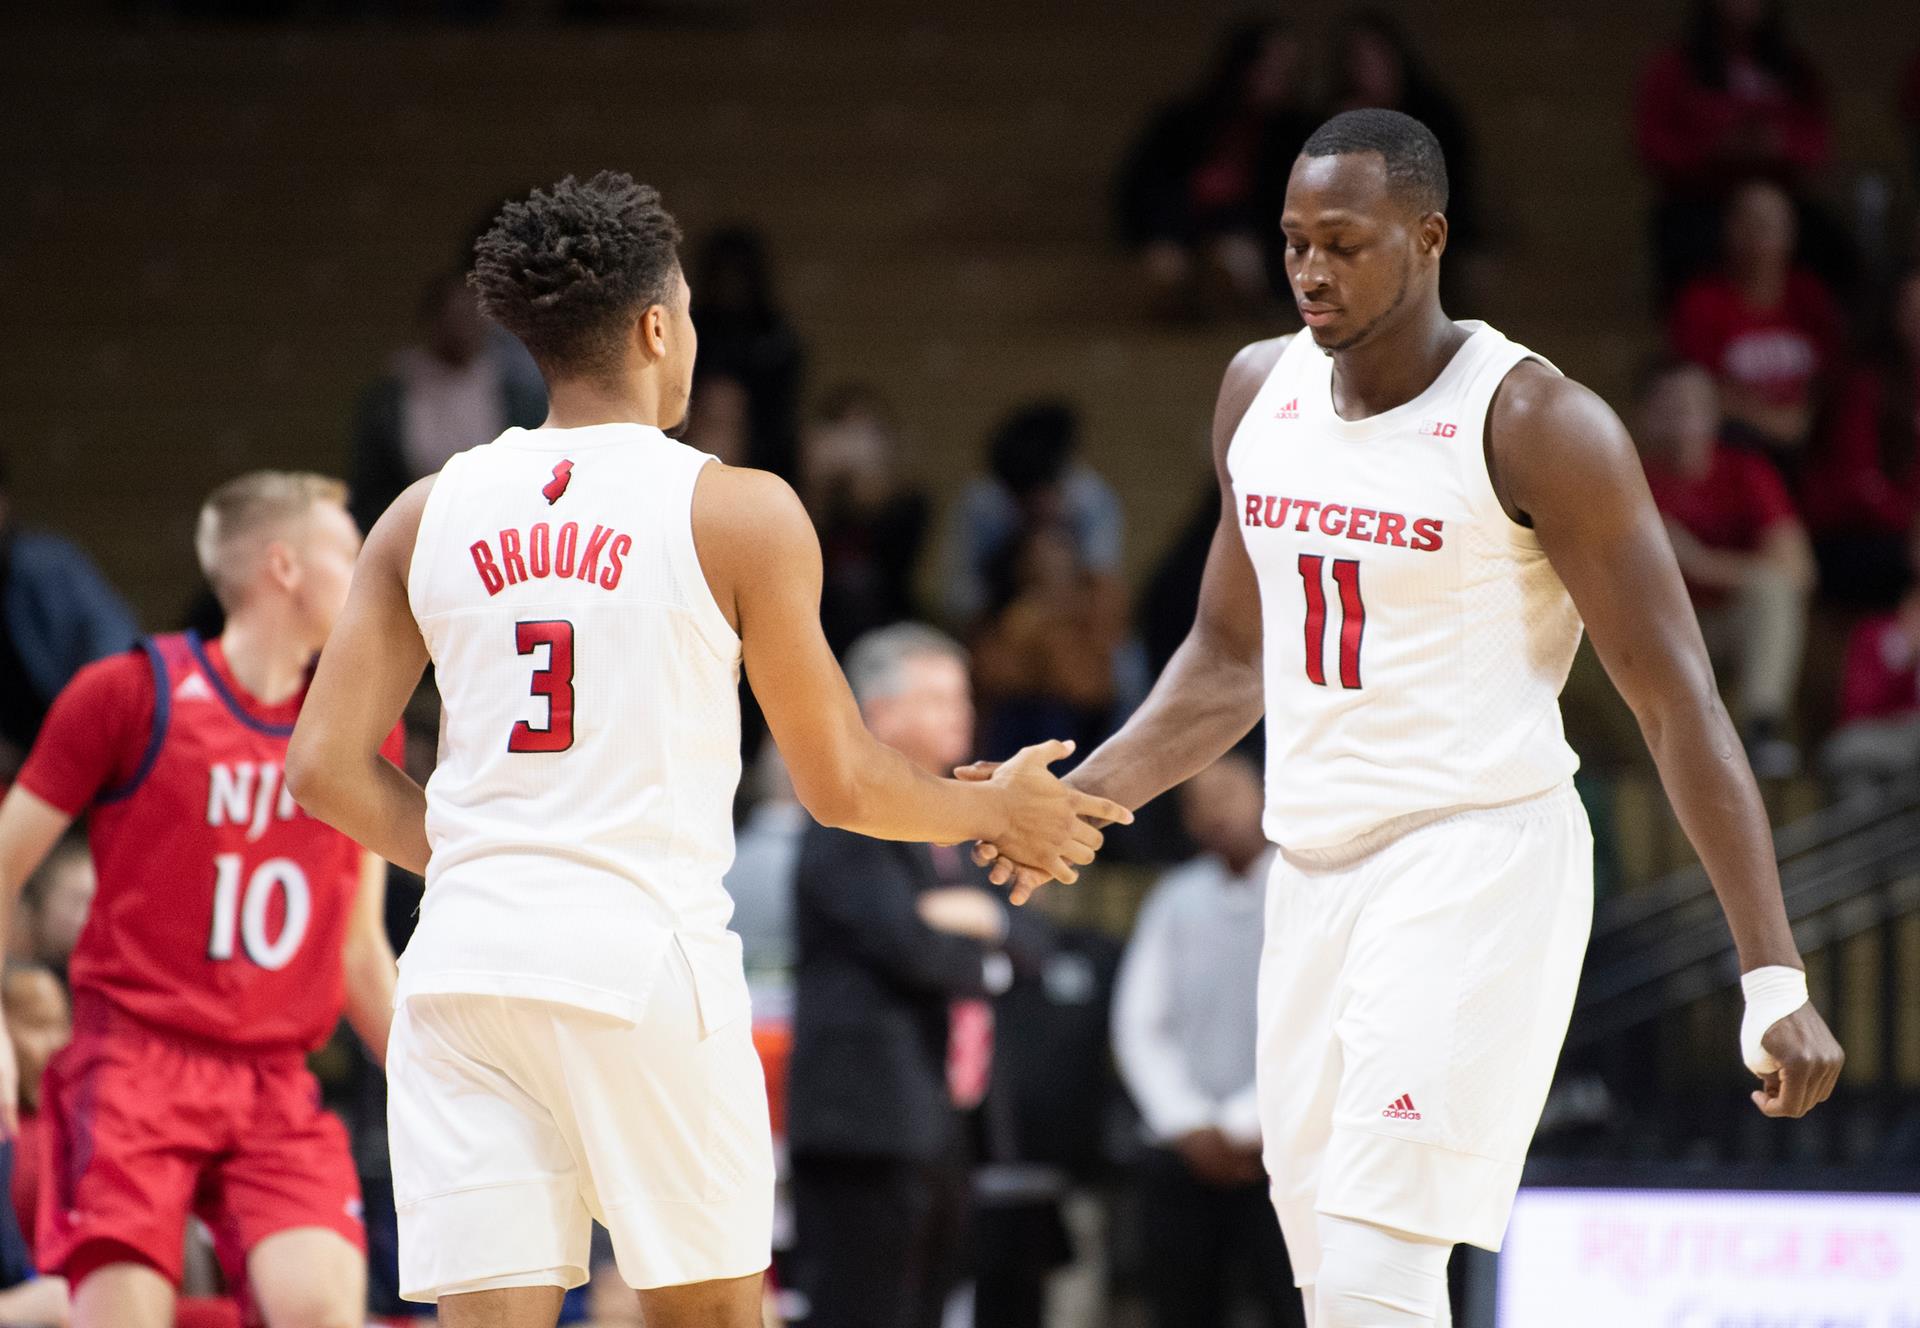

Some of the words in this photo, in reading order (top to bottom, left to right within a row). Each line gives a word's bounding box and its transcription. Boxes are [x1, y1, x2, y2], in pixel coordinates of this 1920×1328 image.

[469, 521, 632, 597] BROOKS
[1245, 494, 1443, 552] RUTGERS
[1298, 553, 1366, 690] 11
[507, 619, 575, 753] 3
[208, 853, 311, 972] 10
[1382, 1109, 1421, 1120] adidas
